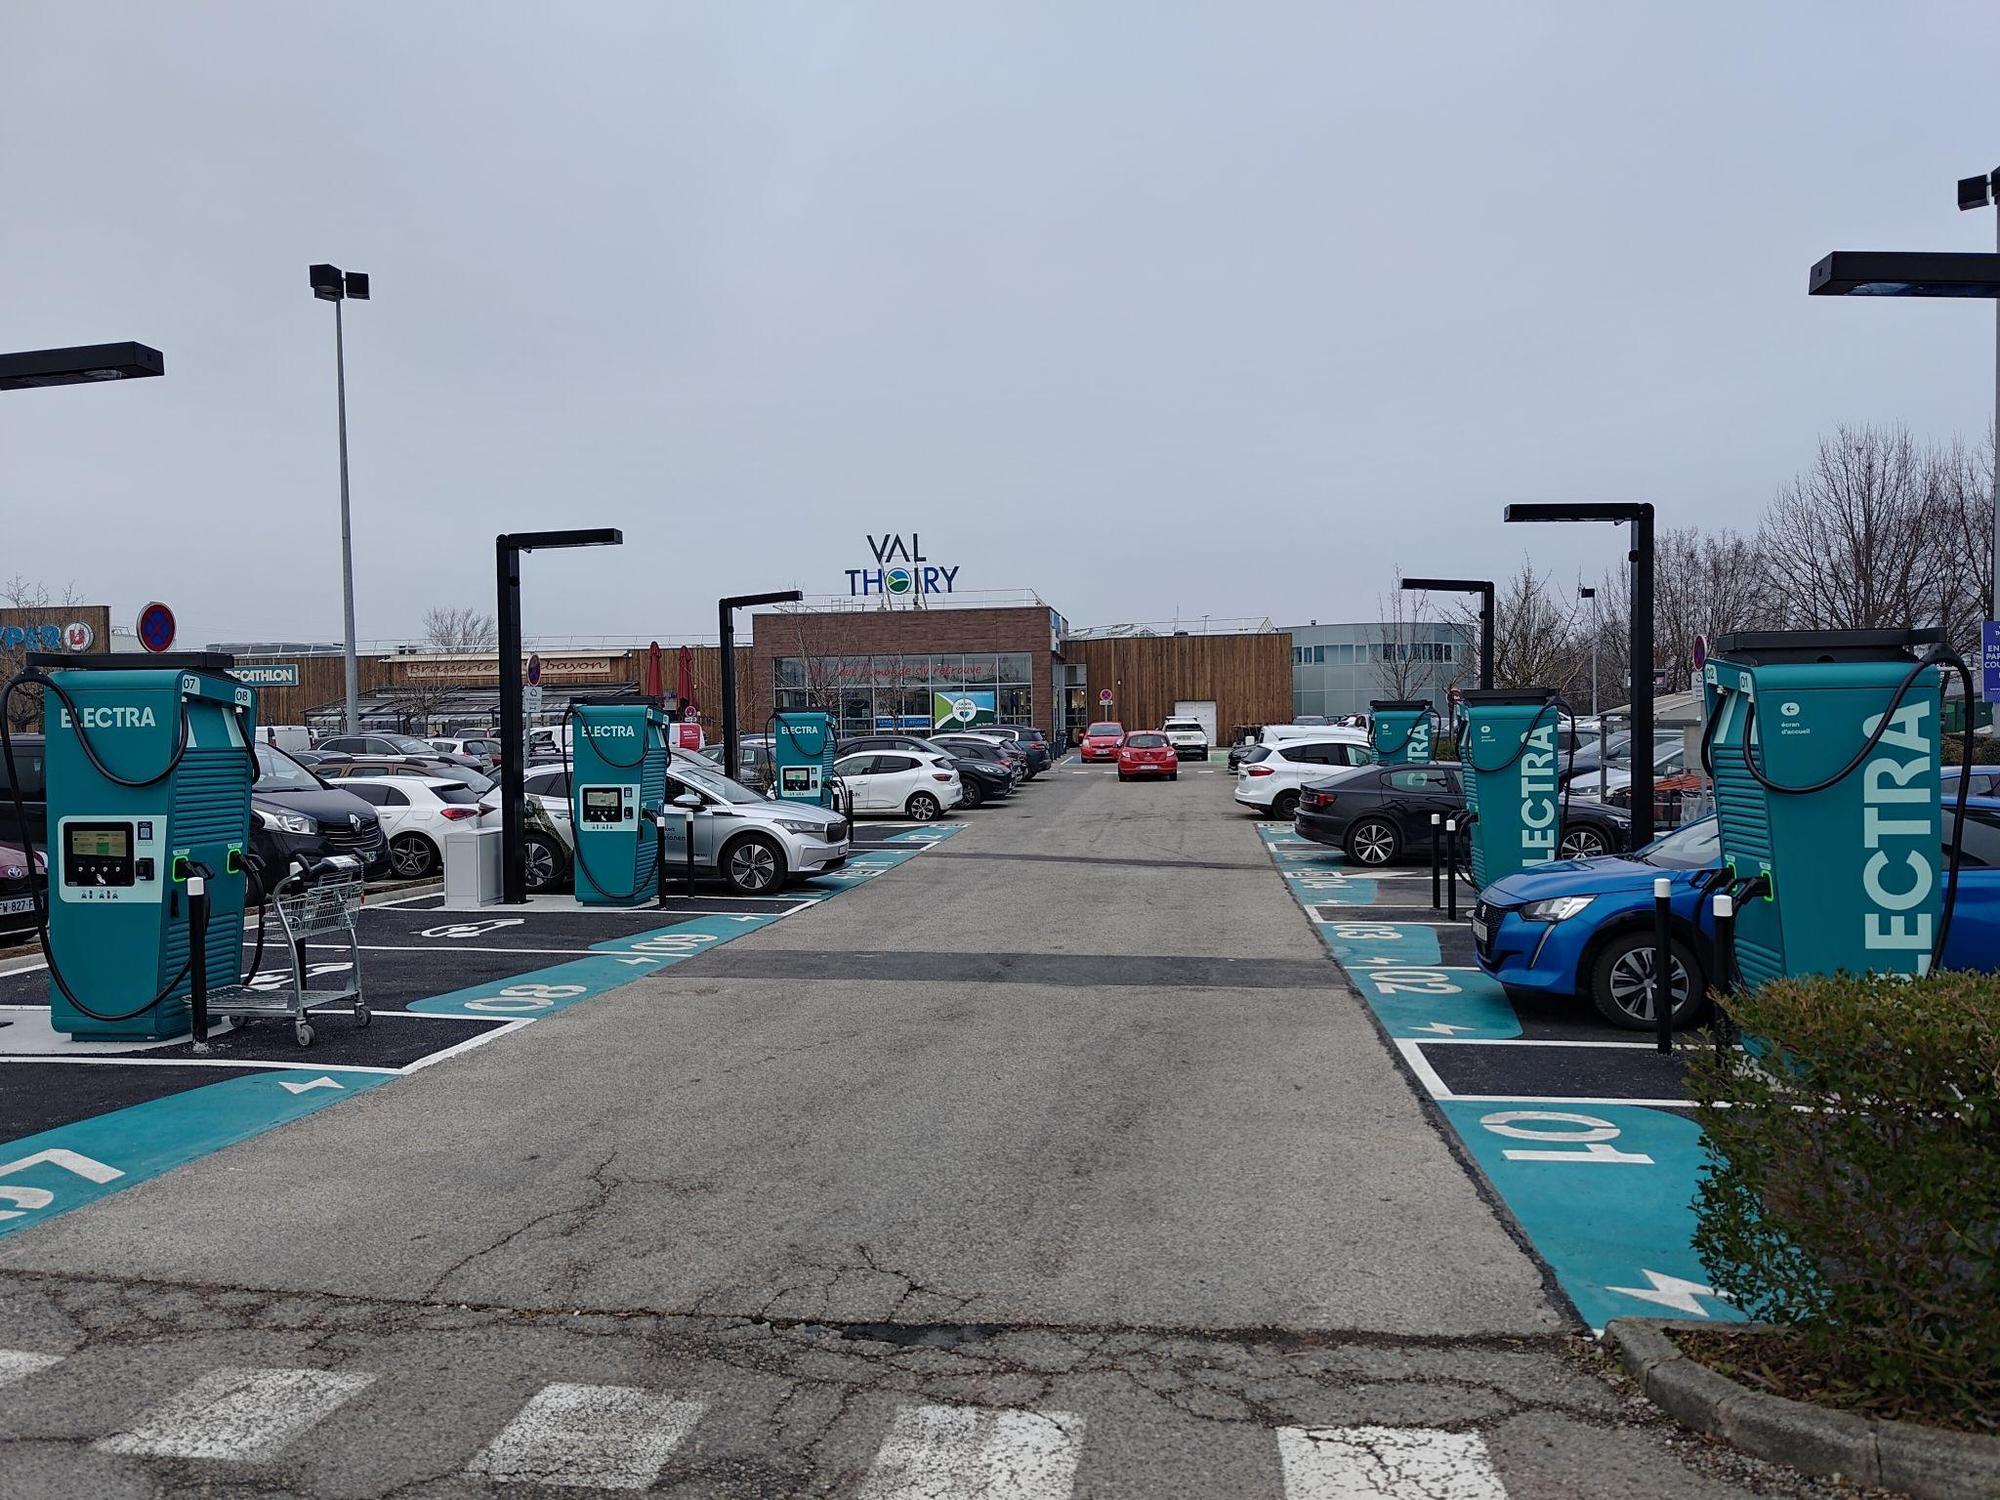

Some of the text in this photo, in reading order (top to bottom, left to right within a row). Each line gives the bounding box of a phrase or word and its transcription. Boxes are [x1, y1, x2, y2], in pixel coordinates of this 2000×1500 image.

[866, 533, 926, 563] VAL
[845, 566, 960, 596] THOIRY
[0, 625, 62, 650] PER
[409, 657, 608, 673] Brasserie bayon
[934, 664, 982, 676] retrouve
[1706, 667, 1715, 679] 02
[183, 678, 195, 689] 07
[1740, 676, 1749, 688] 01
[236, 691, 248, 701] 08
[781, 726, 818, 735] ELECTRA
[1332, 924, 1403, 940] 03
[631, 933, 718, 951] 09
[1368, 970, 1463, 995] 02
[464, 983, 587, 1011] 08
[1480, 1111, 1656, 1165] 01
